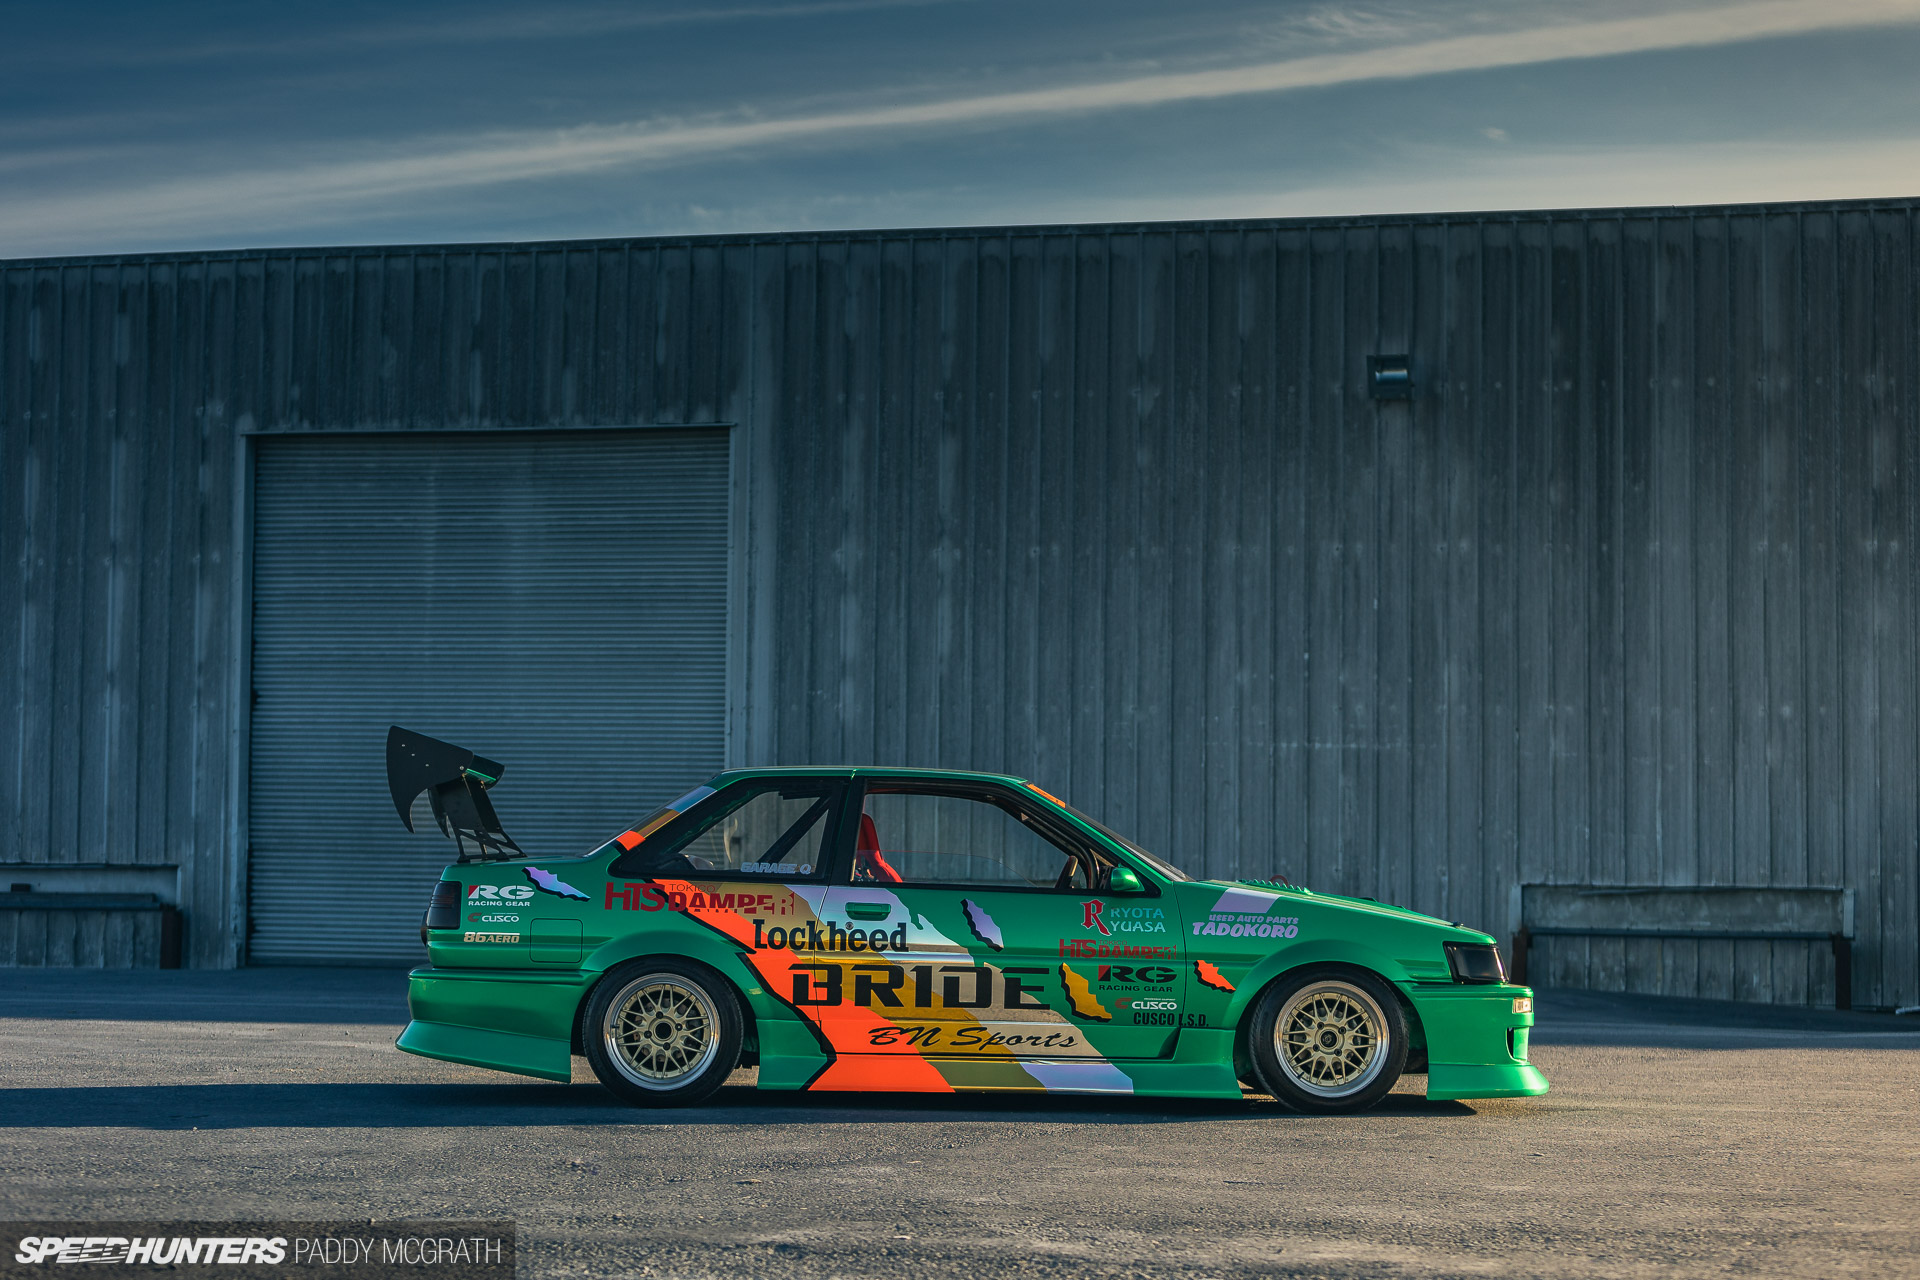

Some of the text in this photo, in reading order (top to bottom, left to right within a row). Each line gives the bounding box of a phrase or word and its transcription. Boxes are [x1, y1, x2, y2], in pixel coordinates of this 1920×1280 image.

[741, 862, 797, 874] GARAGE
[468, 885, 535, 900] RG
[669, 883, 716, 892] TOKICO
[604, 882, 795, 916] HTS DAMPER
[481, 915, 520, 923] CUSCO
[1110, 907, 1165, 919] RYOTA
[1208, 913, 1299, 925] USED AUTO PARTS
[1110, 920, 1166, 933] YUASA
[1192, 921, 1299, 939] TADOKORO
[753, 919, 910, 953] Lockheed
[1058, 938, 1177, 960] HTS DAMPER
[1098, 964, 1178, 984] RG
[787, 963, 1051, 1010] BRIDE
[1131, 1001, 1178, 1011] CUSCO
[1133, 1012, 1175, 1026] CUSCO
[950, 1026, 1079, 1051] Sports
